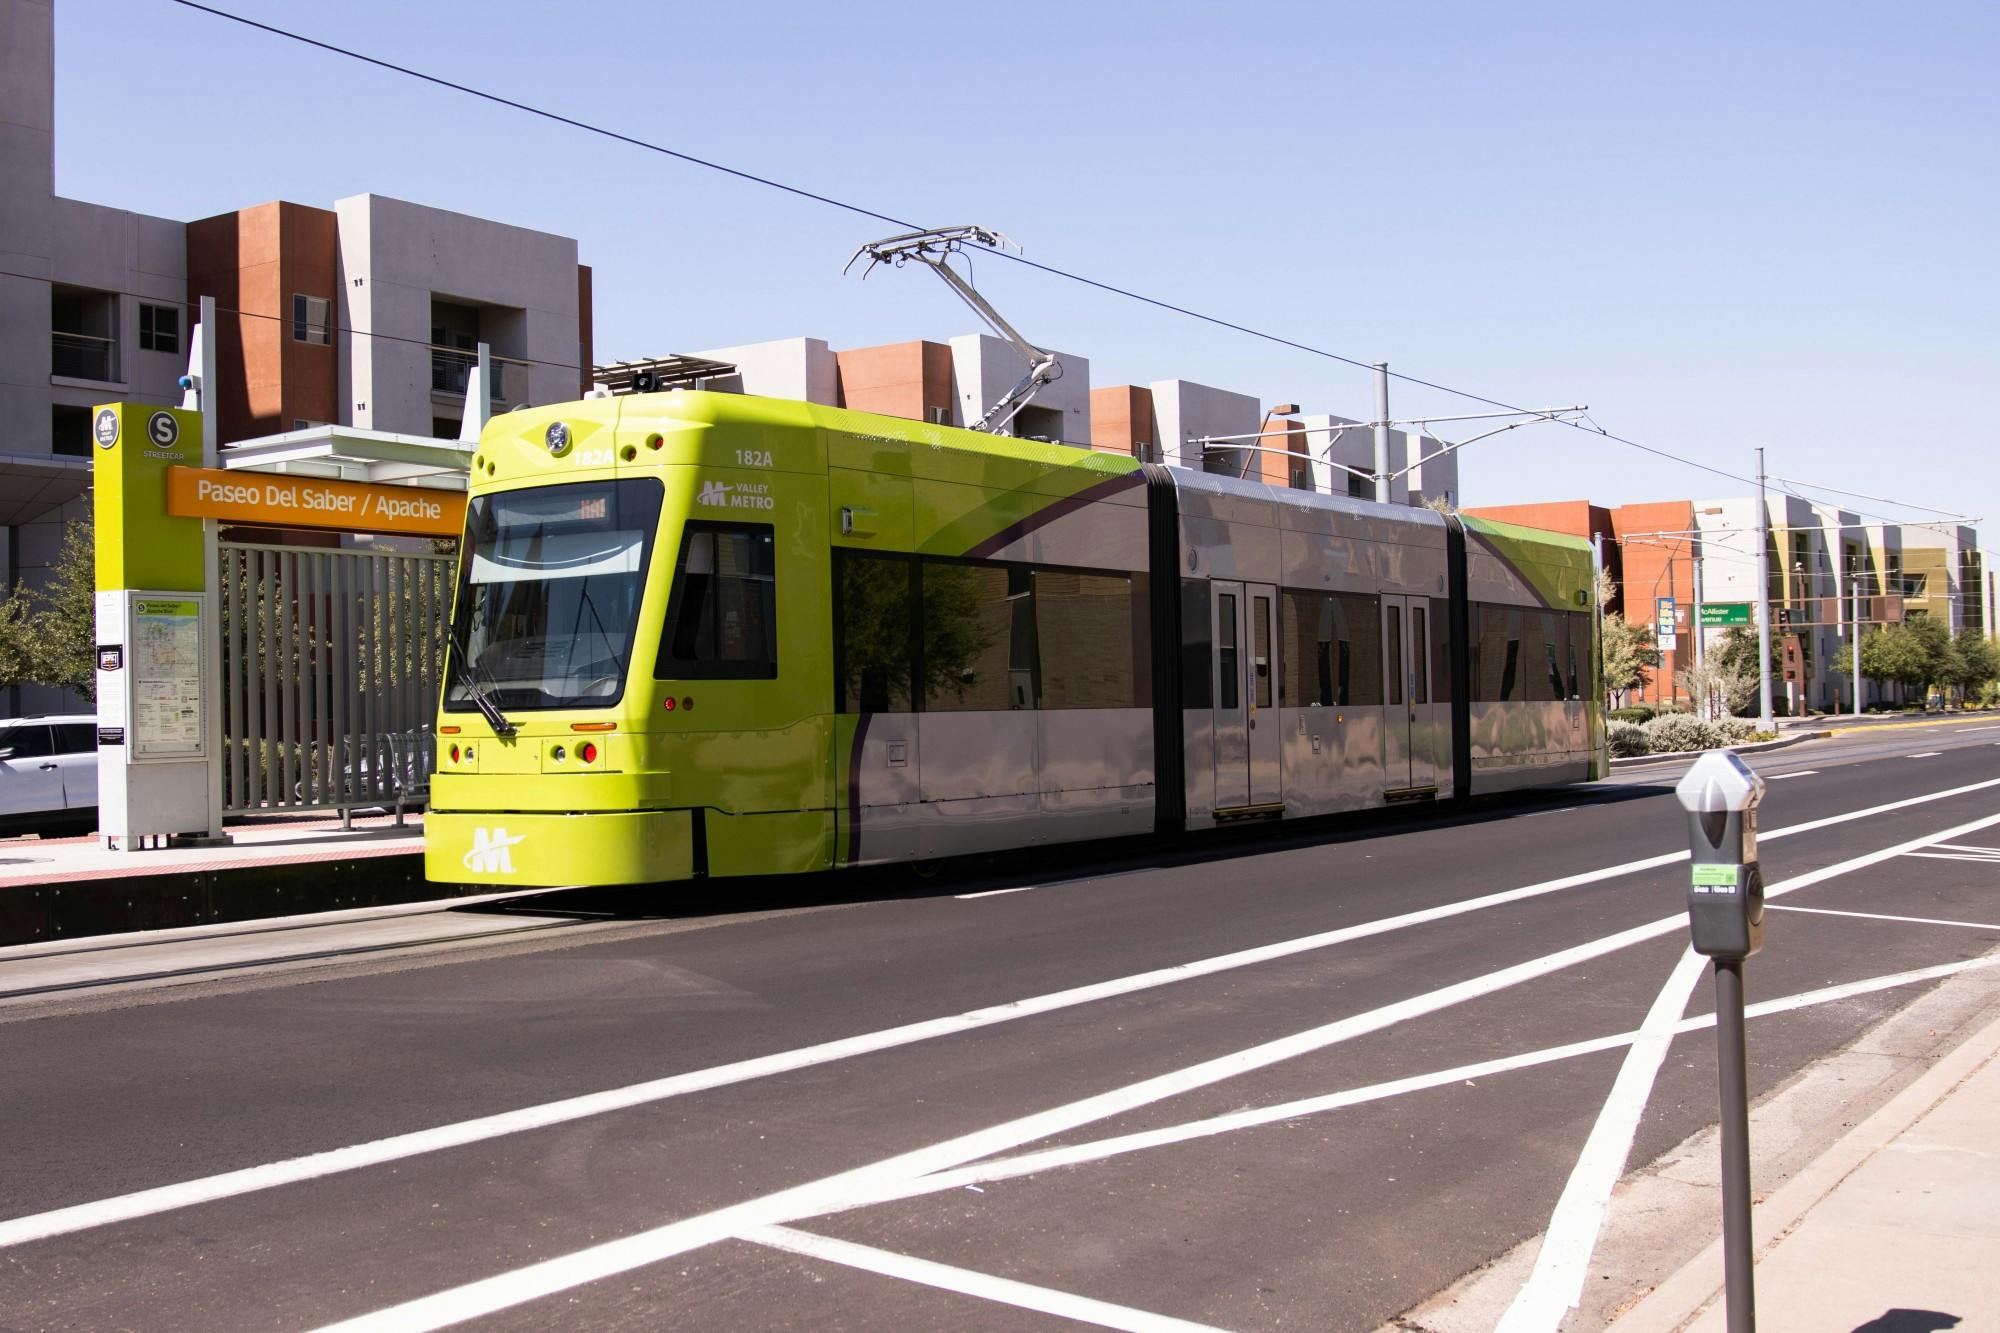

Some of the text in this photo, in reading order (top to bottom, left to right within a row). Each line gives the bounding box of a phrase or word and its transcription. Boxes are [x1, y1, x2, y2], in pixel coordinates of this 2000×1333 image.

[156, 417, 173, 442] S
[144, 450, 184, 460] STREETCAR
[575, 448, 614, 466] 182A
[736, 449, 773, 467] 182A
[736, 483, 769, 494] VALLEY
[198, 479, 440, 520] Paseo Del Saber / Apache
[731, 495, 774, 510] METRO
